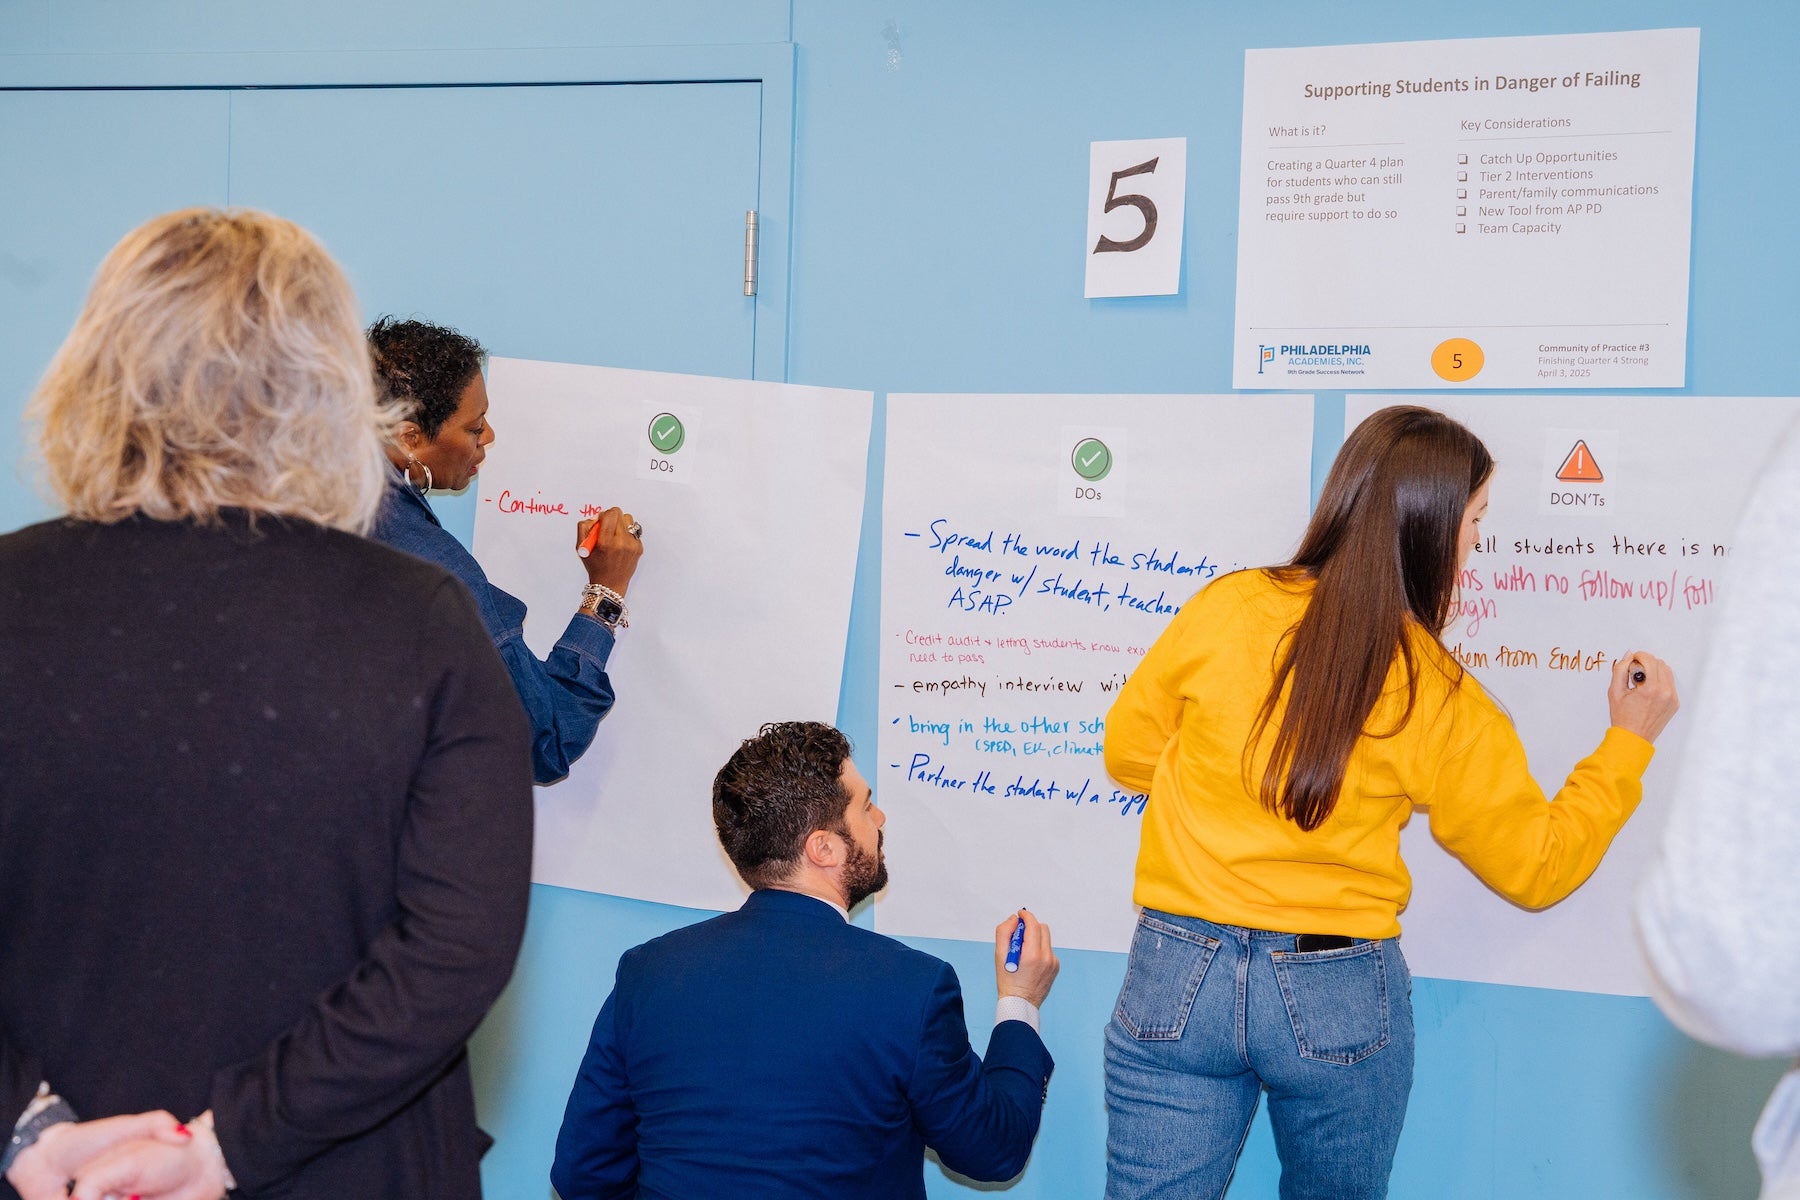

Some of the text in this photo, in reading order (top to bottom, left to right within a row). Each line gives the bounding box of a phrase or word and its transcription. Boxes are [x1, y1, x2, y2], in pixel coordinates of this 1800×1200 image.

[1304, 70, 1641, 100] Supporting Students in Danger of Failing
[1269, 125, 1326, 137] What is it?
[1461, 117, 1572, 132] Key Considerations
[1267, 156, 1404, 172] Creating a Quarter 4 plan
[1480, 150, 1618, 166] Catch Up Opportunities
[1267, 173, 1402, 187] for students who can still
[1480, 169, 1593, 182] Tier 2 Interventions
[1266, 192, 1365, 206] pass 9th grade but
[1479, 184, 1659, 200] Parent/family communications
[1093, 156, 1160, 255] 5
[1479, 203, 1602, 217] New Tool from AP PD
[1265, 208, 1398, 223] require support to do so
[1478, 221, 1561, 235] Team Capacity
[1280, 345, 1371, 355] PHILADELPHIA
[1538, 343, 1650, 353] Community of Practice #3
[1288, 357, 1365, 366] ACADEMIES, INC.
[1452, 352, 1463, 370] 5
[1538, 356, 1649, 366] Finishing Quarter 4 Strong
[1537, 369, 1591, 379] April 3, 2025
[649, 458, 674, 473] DOs
[1074, 487, 1102, 501] DOs
[1550, 492, 1605, 507] DON'Ts
[498, 490, 568, 515] Continue
[929, 518, 993, 553] Spread
[1002, 533, 1028, 556] the
[1035, 540, 1079, 560] word
[1090, 542, 1125, 566] the
[1514, 536, 1595, 555] students
[1612, 535, 1667, 556] there
[1681, 537, 1700, 557] is
[945, 555, 1002, 588] danger
[1011, 565, 1037, 597] w/
[1494, 564, 1536, 593] with
[1545, 573, 1569, 595] no
[1578, 569, 1634, 601] follow
[948, 586, 1013, 617] ASAP.
[905, 629, 942, 646] Credit
[947, 635, 981, 646] audit
[997, 637, 1031, 655] letting
[1033, 637, 1086, 651] students
[1091, 641, 1120, 653] know
[1127, 646, 1151, 656] exa
[909, 652, 985, 664] need to pass
[1450, 642, 1489, 669] them
[1496, 645, 1538, 669] from
[1585, 650, 1607, 673] of
[912, 674, 986, 697] empathy
[996, 674, 1084, 693] interview
[909, 714, 950, 745] bring
[959, 718, 973, 734] in
[983, 716, 1016, 734] the
[1021, 716, 1069, 735] other
[975, 738, 1017, 757] (SPED,
[908, 753, 967, 789] Partner
[972, 771, 995, 794] the
[1004, 775, 1060, 800] student
[1066, 778, 1090, 806] w/
[1090, 793, 1099, 804] a
